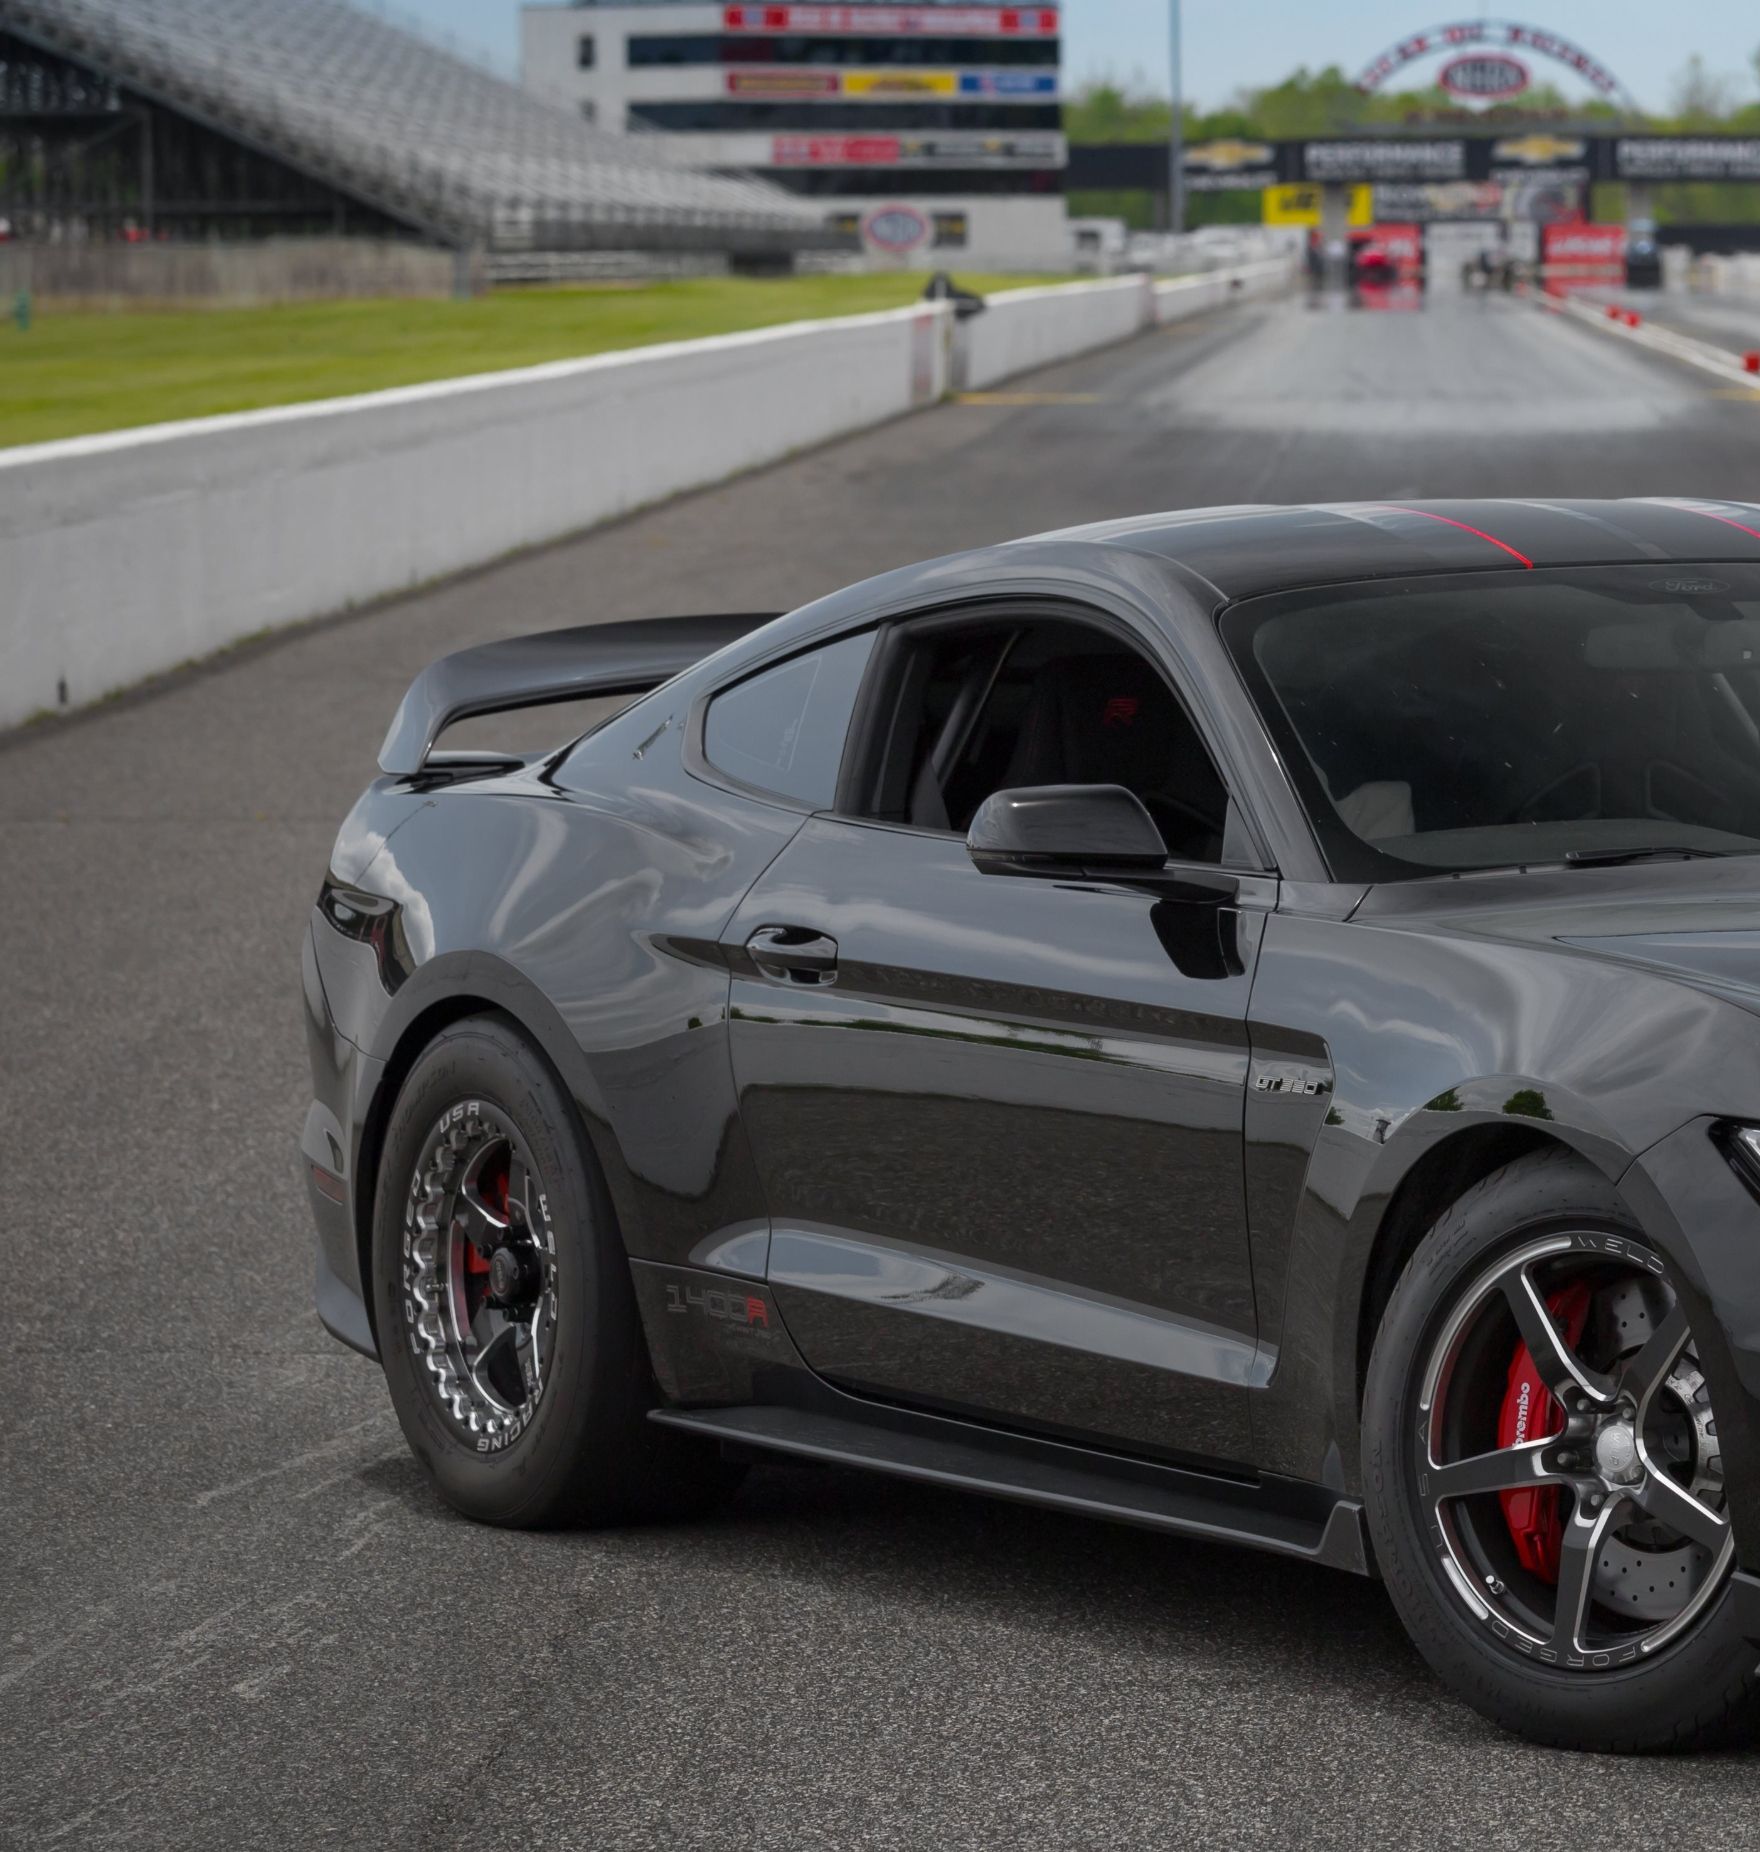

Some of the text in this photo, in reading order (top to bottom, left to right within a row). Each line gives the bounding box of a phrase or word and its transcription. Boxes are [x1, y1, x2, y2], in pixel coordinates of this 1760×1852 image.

[1665, 580, 1714, 592] Ford
[1256, 1076, 1318, 1095] GT350
[440, 1102, 480, 1133] USA
[1578, 1236, 1664, 1274] WELD
[1491, 1620, 1636, 1667] FORGED
